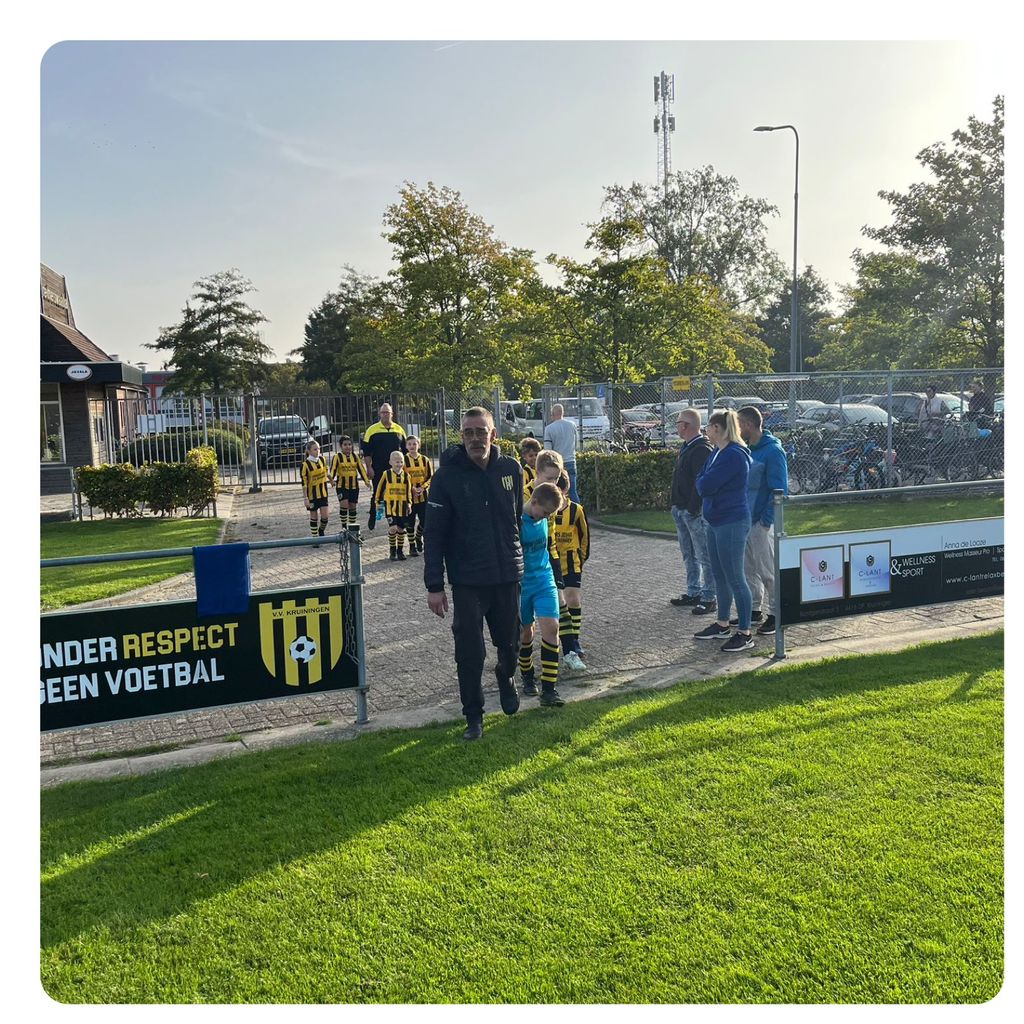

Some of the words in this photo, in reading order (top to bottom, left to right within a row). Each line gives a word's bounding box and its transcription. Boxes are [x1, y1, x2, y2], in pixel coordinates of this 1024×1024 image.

[944, 541, 959, 549] Anna
[960, 540, 969, 548] de
[890, 559, 902, 576] &
[902, 555, 936, 566] WELLNESS
[902, 567, 924, 578] SPORT
[286, 606, 330, 616] KRUININGEN
[122, 622, 239, 659] RESPECT
[105, 658, 225, 695] VOETBAL
